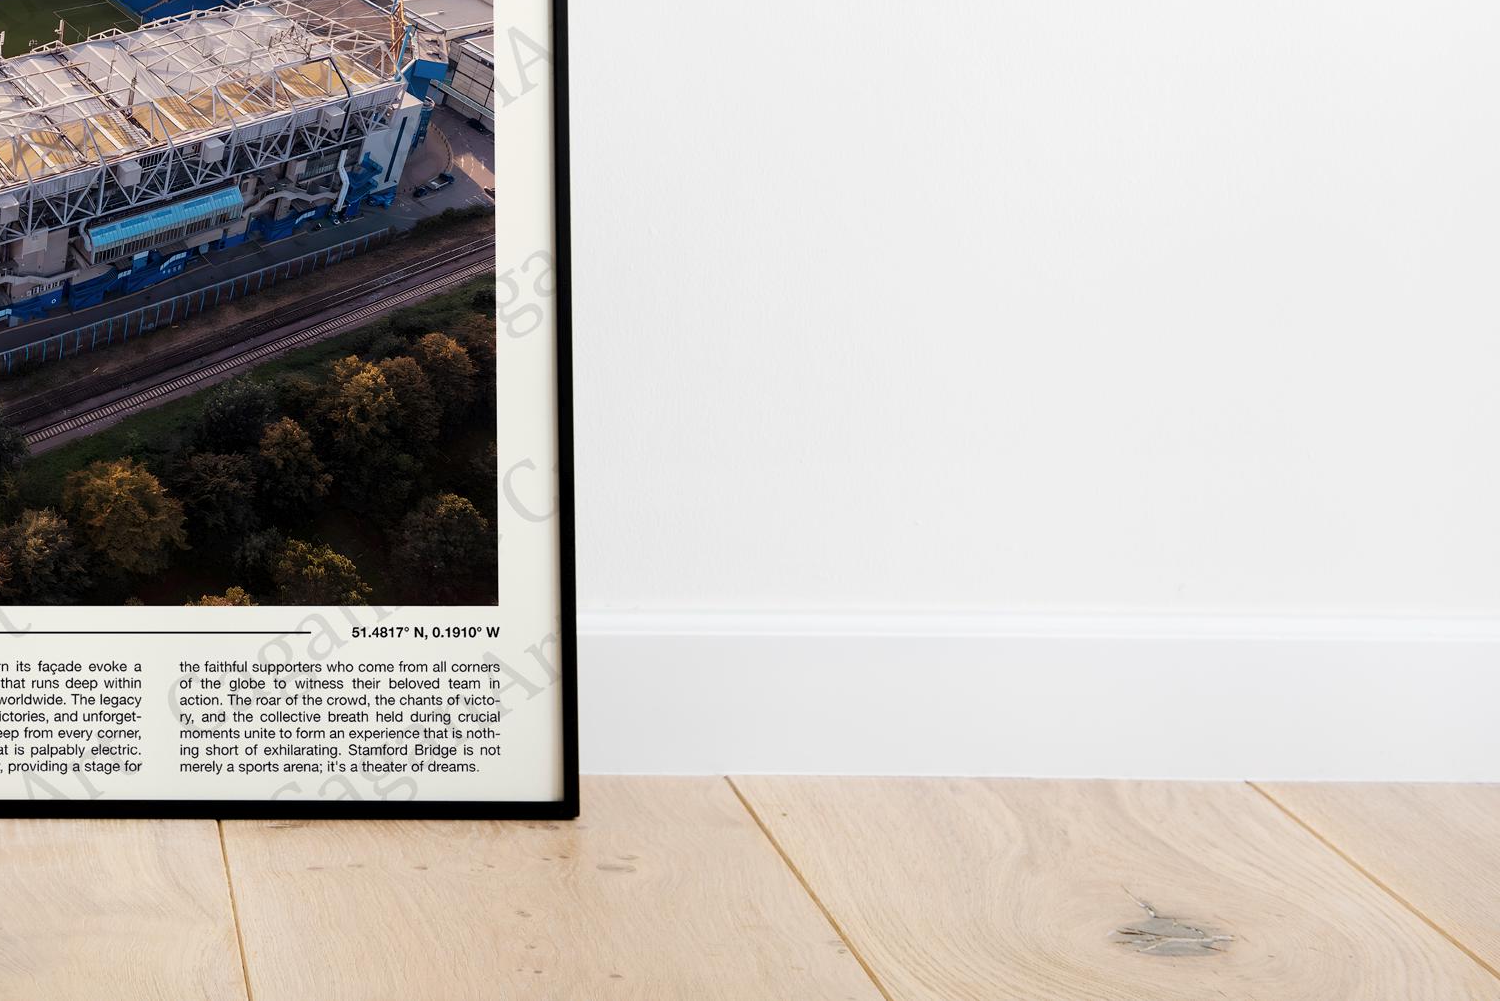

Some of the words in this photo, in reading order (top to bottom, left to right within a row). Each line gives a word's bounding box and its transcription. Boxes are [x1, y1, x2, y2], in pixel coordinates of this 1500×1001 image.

[413, 626, 429, 641] N,
[485, 626, 501, 639] W
[16, 660, 32, 673] its
[37, 660, 82, 676] façade
[88, 660, 128, 673] evoke
[133, 663, 142, 673] a
[179, 660, 201, 673] the
[204, 660, 248, 673] faithful
[251, 661, 323, 676] supporters
[326, 660, 354, 673] who
[358, 663, 395, 673] come
[398, 660, 428, 673] from
[432, 660, 447, 673] all
[451, 663, 501, 673] corners
[179, 677, 193, 690] of
[199, 677, 222, 690] the
[229, 677, 266, 692] globe
[273, 678, 287, 690] to
[294, 677, 344, 690] witness
[351, 677, 381, 690] their
[388, 677, 440, 690] beloved
[447, 678, 481, 690] team
[489, 677, 501, 690] in
[70, 693, 96, 706] The
[99, 693, 142, 709] legacy
[179, 694, 223, 706] action.
[227, 693, 252, 706] The
[255, 696, 282, 706] roar
[285, 693, 299, 706] of
[301, 694, 323, 706] the
[326, 694, 371, 708] crowd,
[374, 694, 396, 706] the
[399, 694, 443, 706] chants
[446, 693, 460, 706] of
[463, 694, 501, 706] victo-
[53, 710, 78, 723] and
[82, 710, 142, 726] unforget-
[179, 713, 195, 726] ry,
[201, 710, 226, 723] and
[232, 710, 254, 723] the
[259, 710, 321, 723] collective
[327, 710, 369, 723] breath
[375, 710, 404, 723] held
[410, 710, 452, 726] during
[457, 710, 501, 723] crucial
[14, 743, 25, 756] is
[30, 743, 86, 759] palpably
[90, 743, 142, 756] electric.
[179, 744, 200, 759] ing
[205, 743, 239, 756] short
[244, 743, 258, 756] of
[263, 743, 342, 759] exhilarating.
[348, 743, 408, 756] Stamford
[414, 743, 458, 759] Bridge
[463, 744, 474, 756] is
[480, 744, 501, 756] not
[8, 760, 68, 776] providing
[72, 762, 81, 773] a
[84, 760, 121, 776] stage
[123, 759, 143, 772] for
